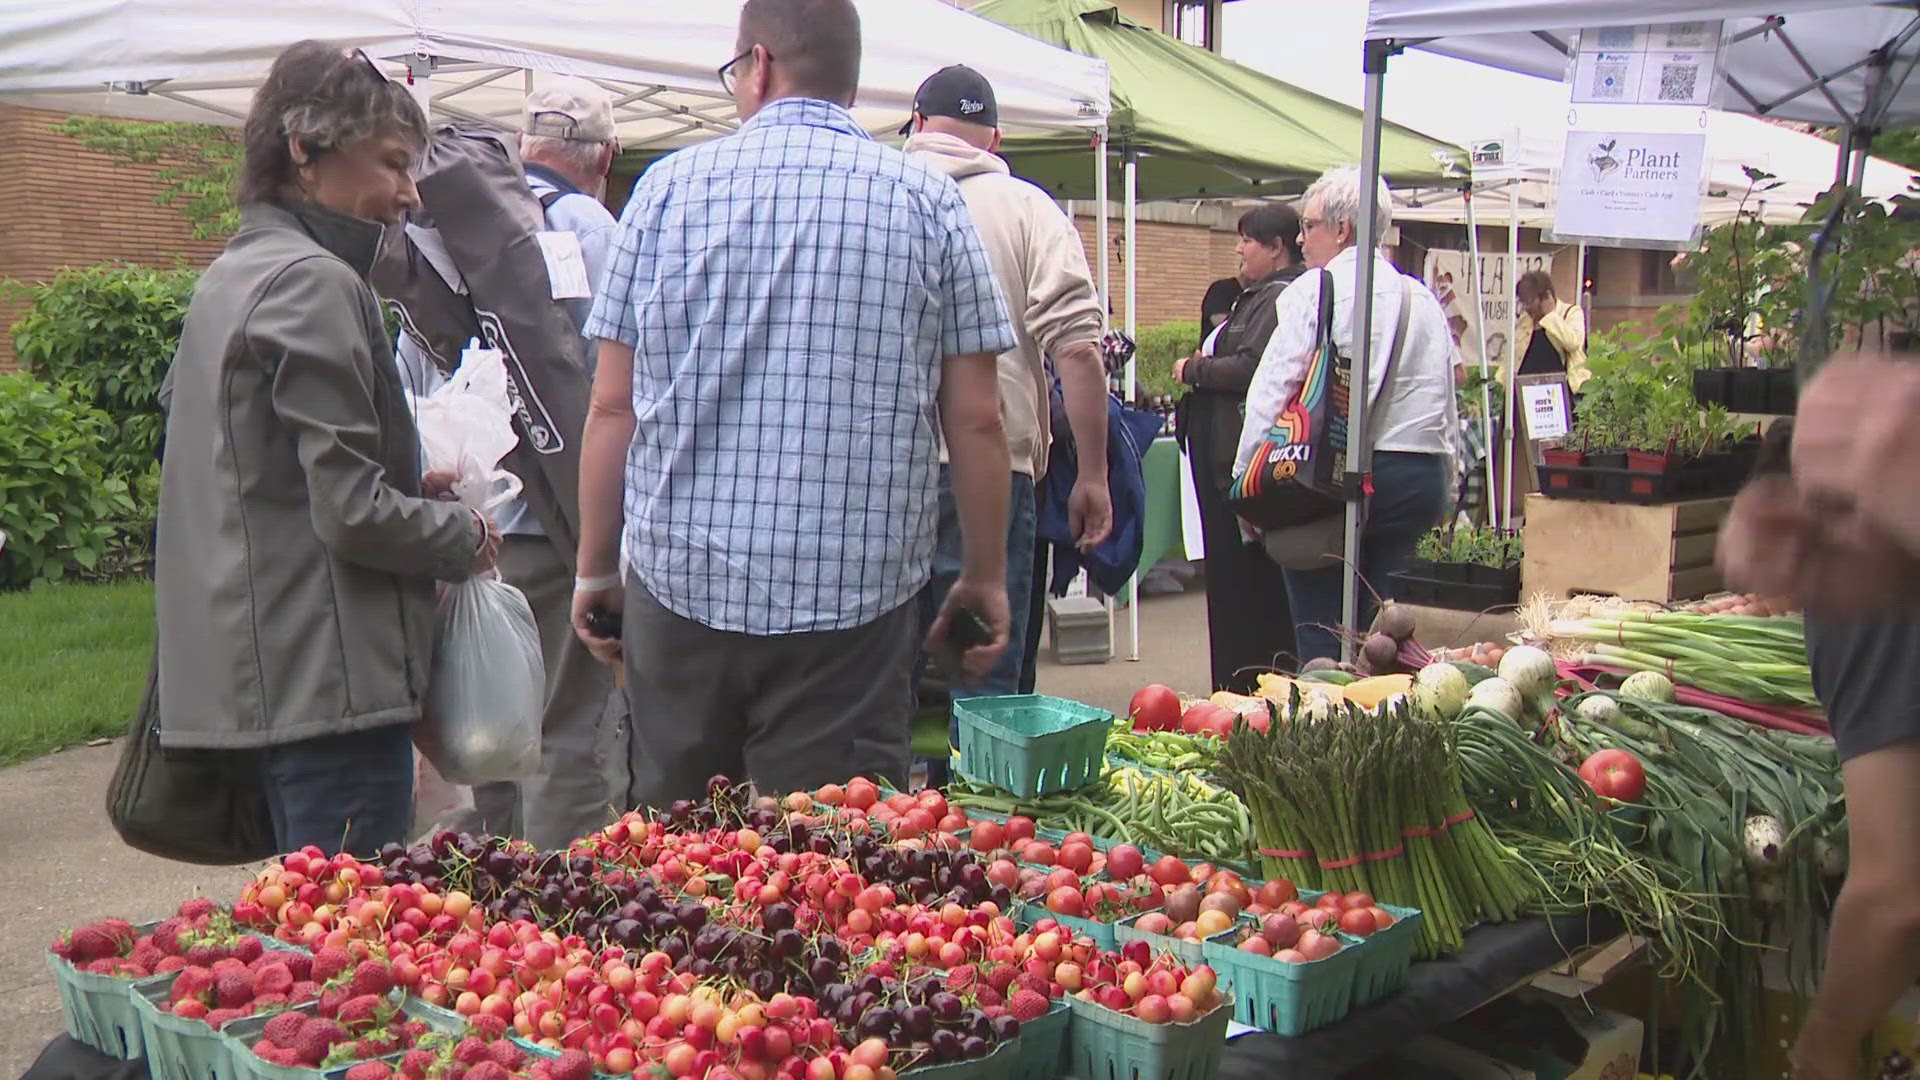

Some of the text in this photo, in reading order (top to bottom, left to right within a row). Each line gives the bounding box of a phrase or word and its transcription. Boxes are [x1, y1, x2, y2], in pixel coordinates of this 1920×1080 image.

[1627, 148, 1680, 168] Plant
[1624, 167, 1679, 180] Partners
[1661, 192, 1673, 200] App
[1268, 445, 1310, 463] WXXI
[1273, 460, 1297, 480] 60
